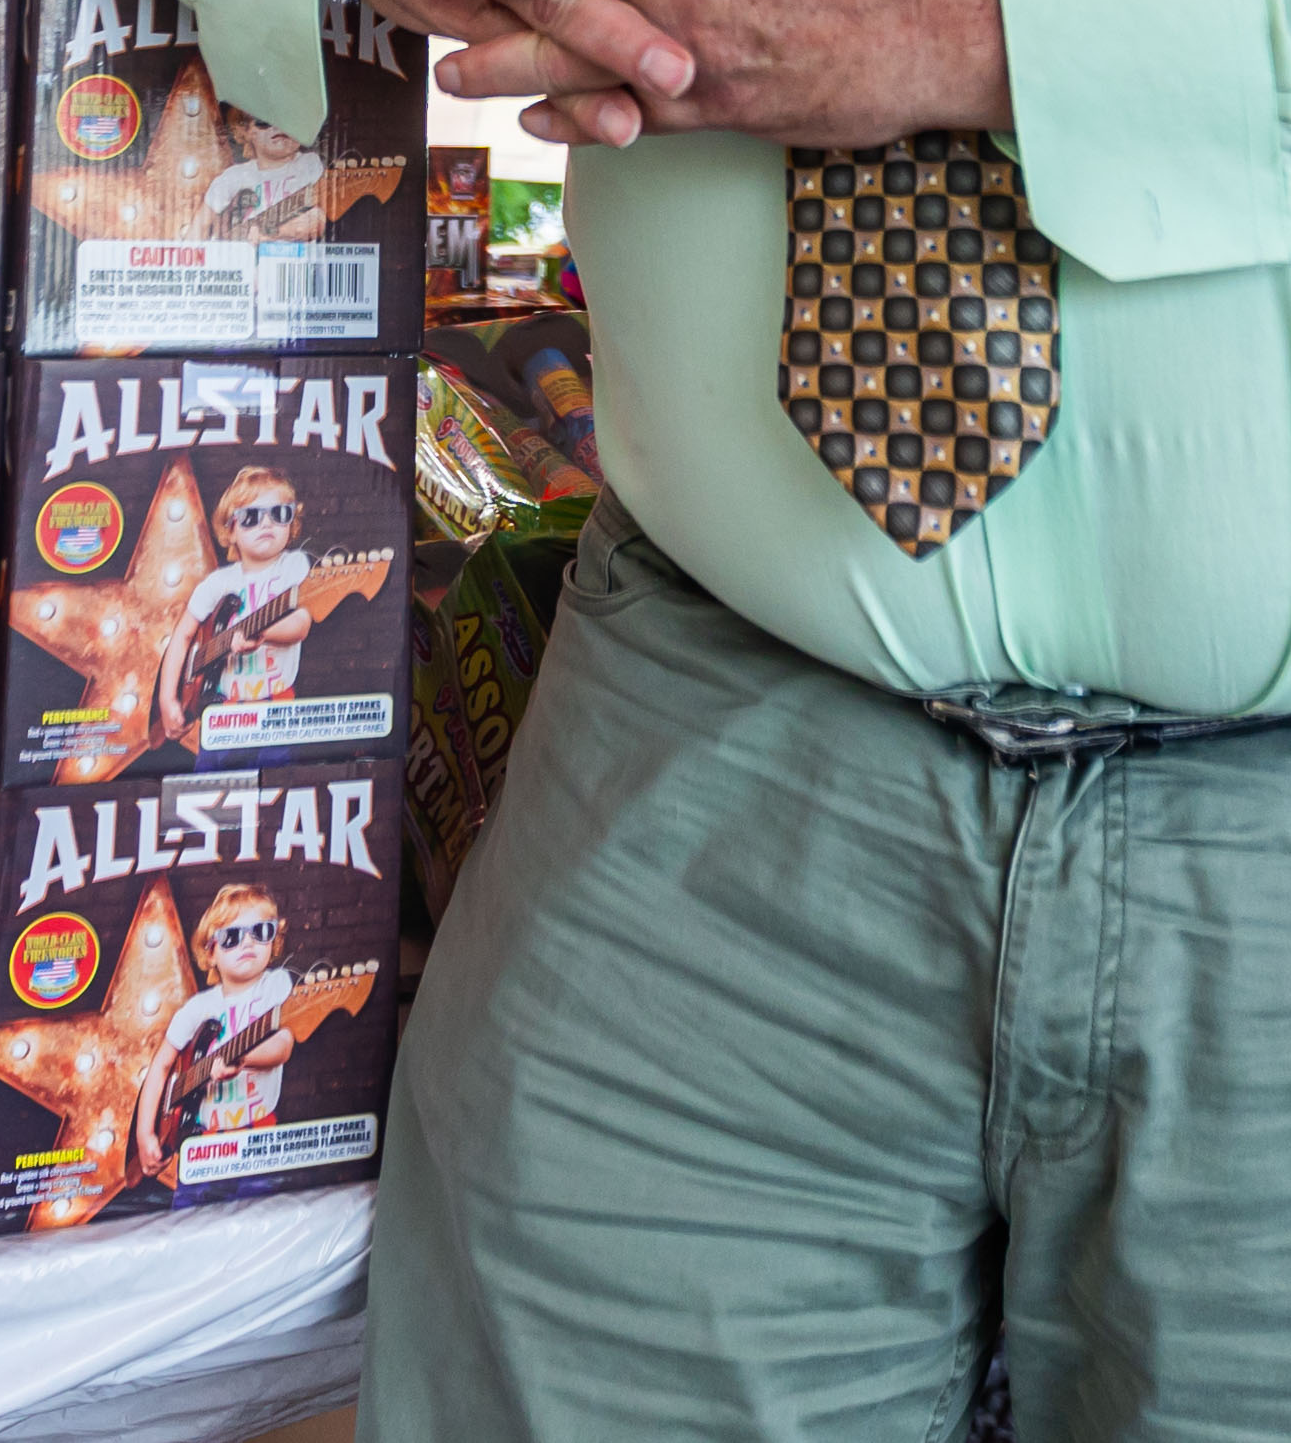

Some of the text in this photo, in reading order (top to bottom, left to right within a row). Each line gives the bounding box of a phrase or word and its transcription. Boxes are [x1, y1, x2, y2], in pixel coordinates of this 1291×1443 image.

[130, 247, 206, 267] CAUTION
[354, 246, 375, 255] CHINA
[208, 712, 258, 729] CAUTION
[247, 1132, 274, 1146] EMITS
[276, 1126, 319, 1143] SHOWERS
[331, 1120, 366, 1135] SPARKS
[187, 1141, 238, 1163] CAUTION
[241, 1145, 267, 1159] SPINS
[282, 1138, 319, 1153] GROUND
[320, 1131, 371, 1148] FLAMMABLE
[15, 1147, 85, 1169] PERFORMANCE
